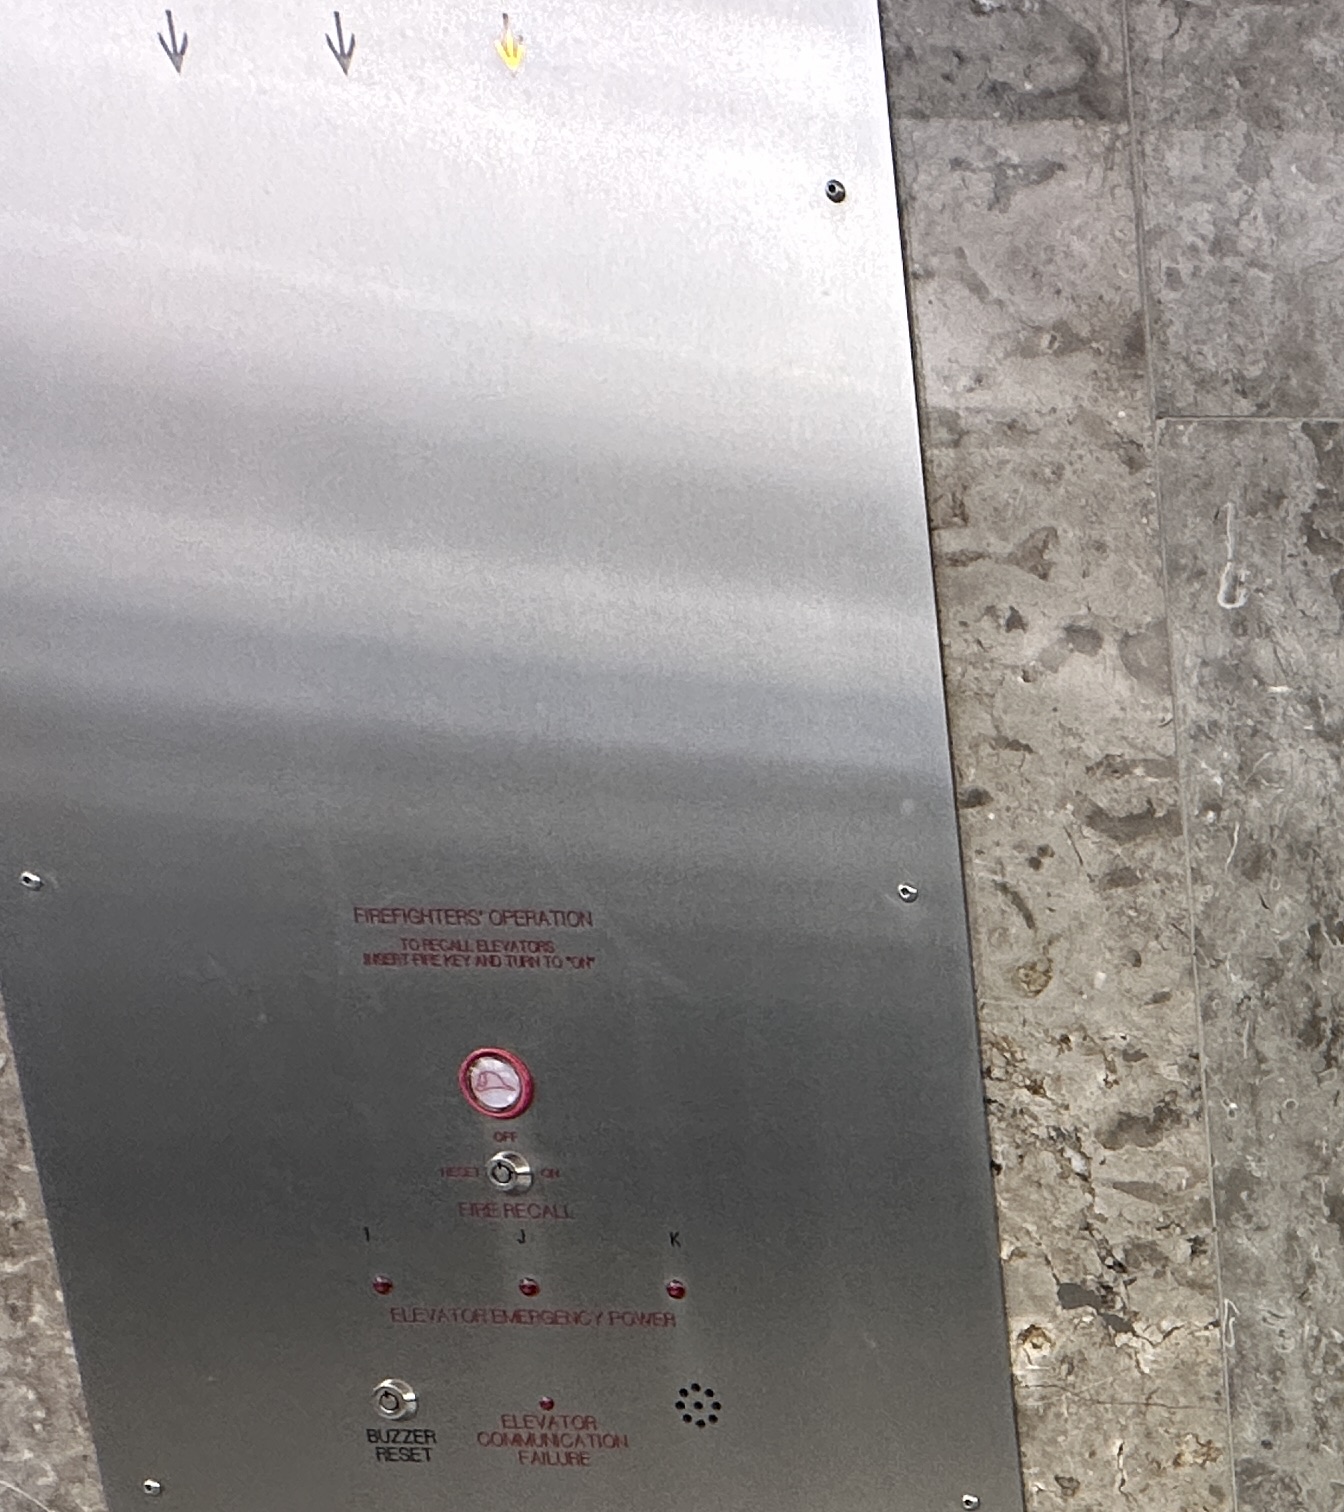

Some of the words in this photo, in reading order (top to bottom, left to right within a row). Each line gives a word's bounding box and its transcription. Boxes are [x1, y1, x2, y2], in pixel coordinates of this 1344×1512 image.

[354, 907, 483, 925] FIREFIGHTERS'
[489, 910, 593, 927] OPERATION
[401, 938, 419, 951] TO
[423, 939, 468, 952] RECALL
[477, 939, 555, 953] ELEVATORS
[363, 953, 408, 966] INSERT
[412, 954, 440, 967] FIRE
[442, 955, 470, 967] KEY
[475, 955, 500, 967] AND
[502, 956, 539, 968] TURN
[544, 956, 562, 968] TO
[493, 1131, 517, 1142] OFF
[459, 1202, 498, 1218] FIRE
[503, 1203, 574, 1219] RECALL
[517, 1229, 526, 1244] J
[670, 1232, 681, 1247] K
[390, 1307, 490, 1324] ELEVATOR
[492, 1309, 602, 1326] EMERGENCY
[609, 1312, 676, 1328] POWER
[502, 1414, 597, 1430] ELEVATOR
[366, 1428, 437, 1445] BUZZER
[477, 1431, 628, 1448] COMMUNICATION
[376, 1447, 432, 1463] RESET
[519, 1451, 591, 1467] FAILURE
